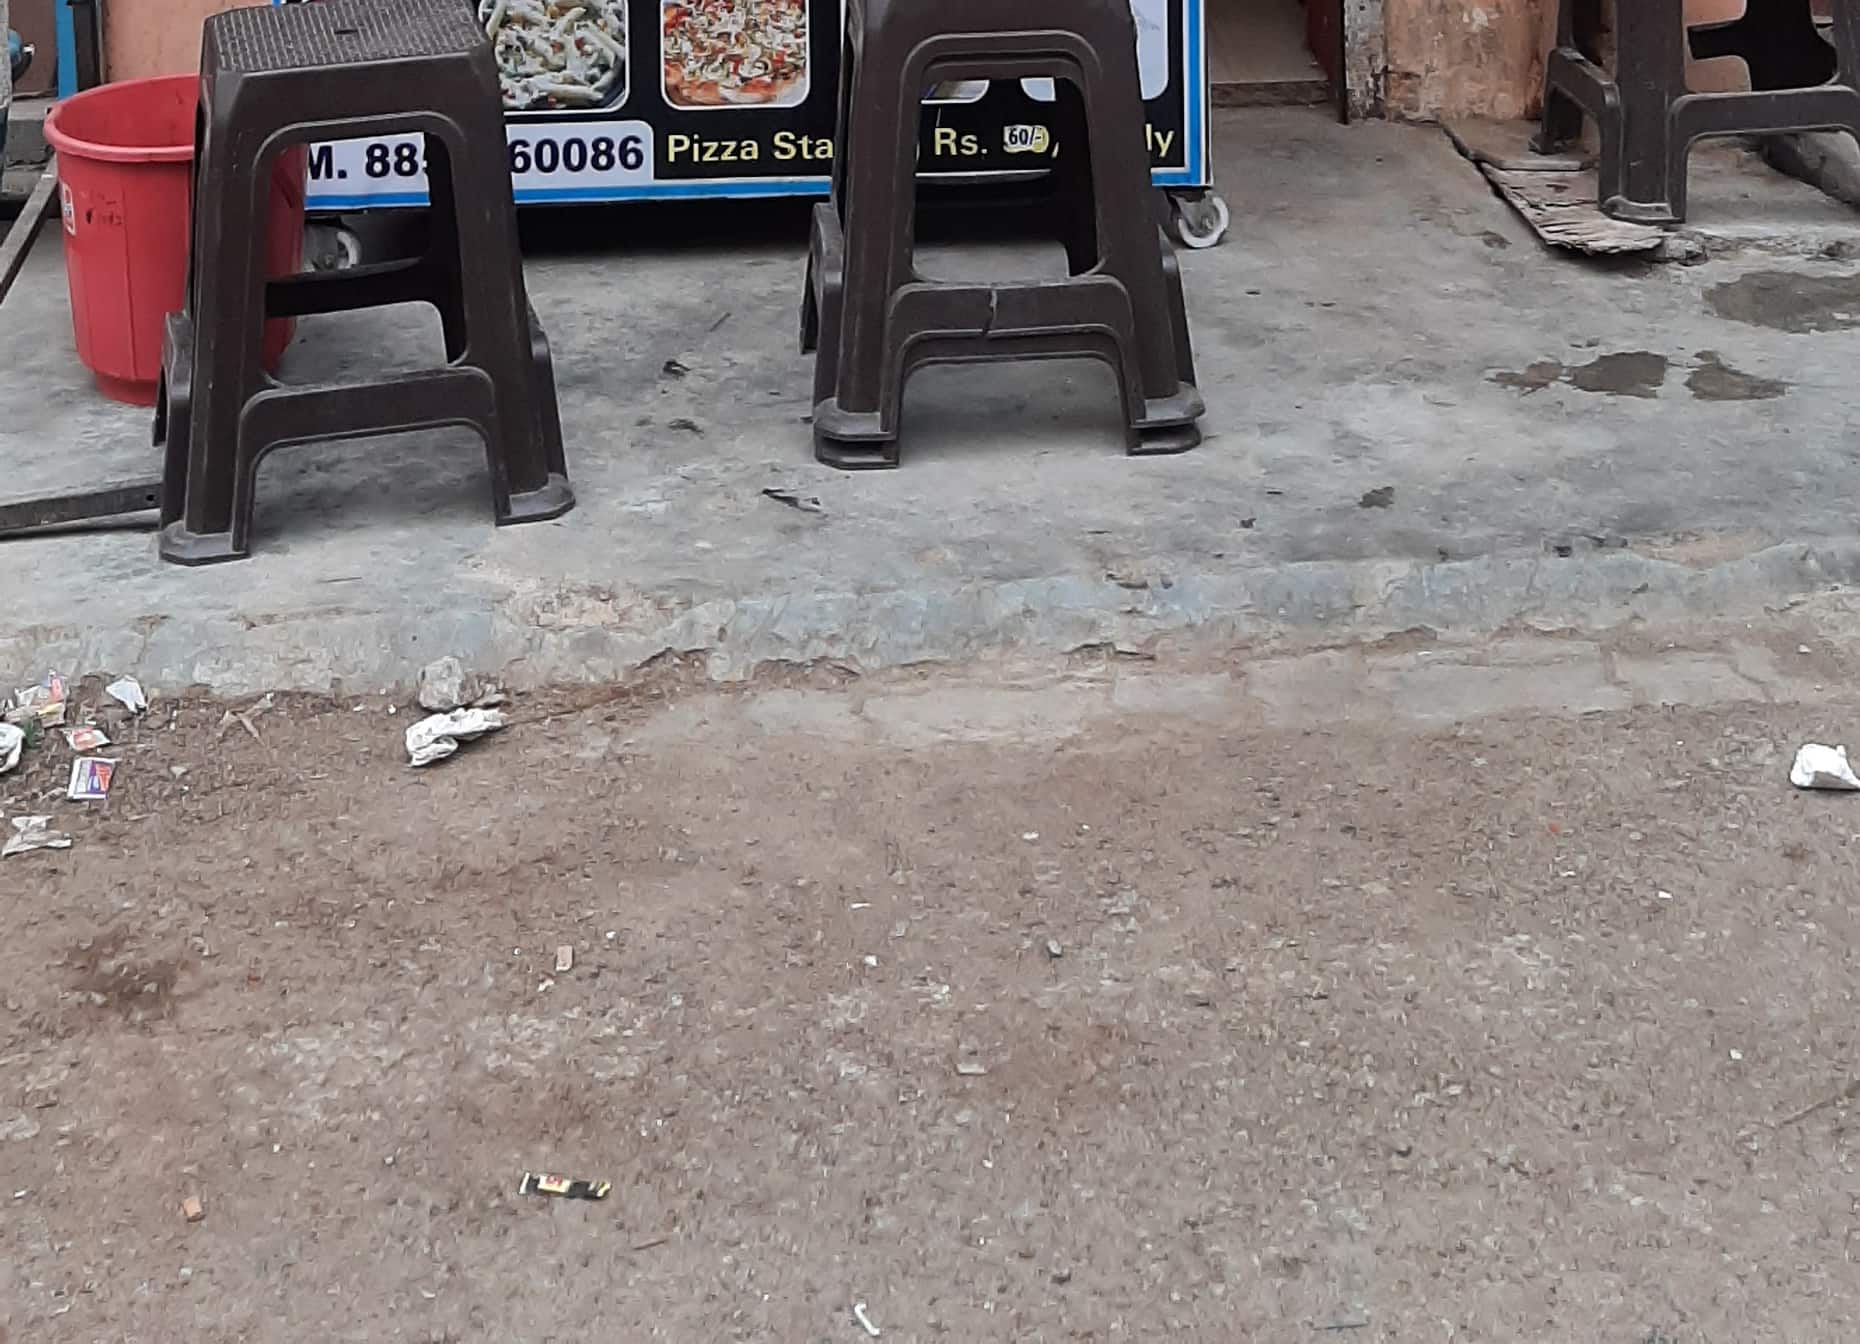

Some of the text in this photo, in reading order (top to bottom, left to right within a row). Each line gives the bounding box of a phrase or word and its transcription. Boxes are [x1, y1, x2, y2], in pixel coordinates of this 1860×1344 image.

[308, 135, 644, 180] M. 8860086
[667, 133, 760, 163] Pizza
[934, 127, 988, 156] Rs.
